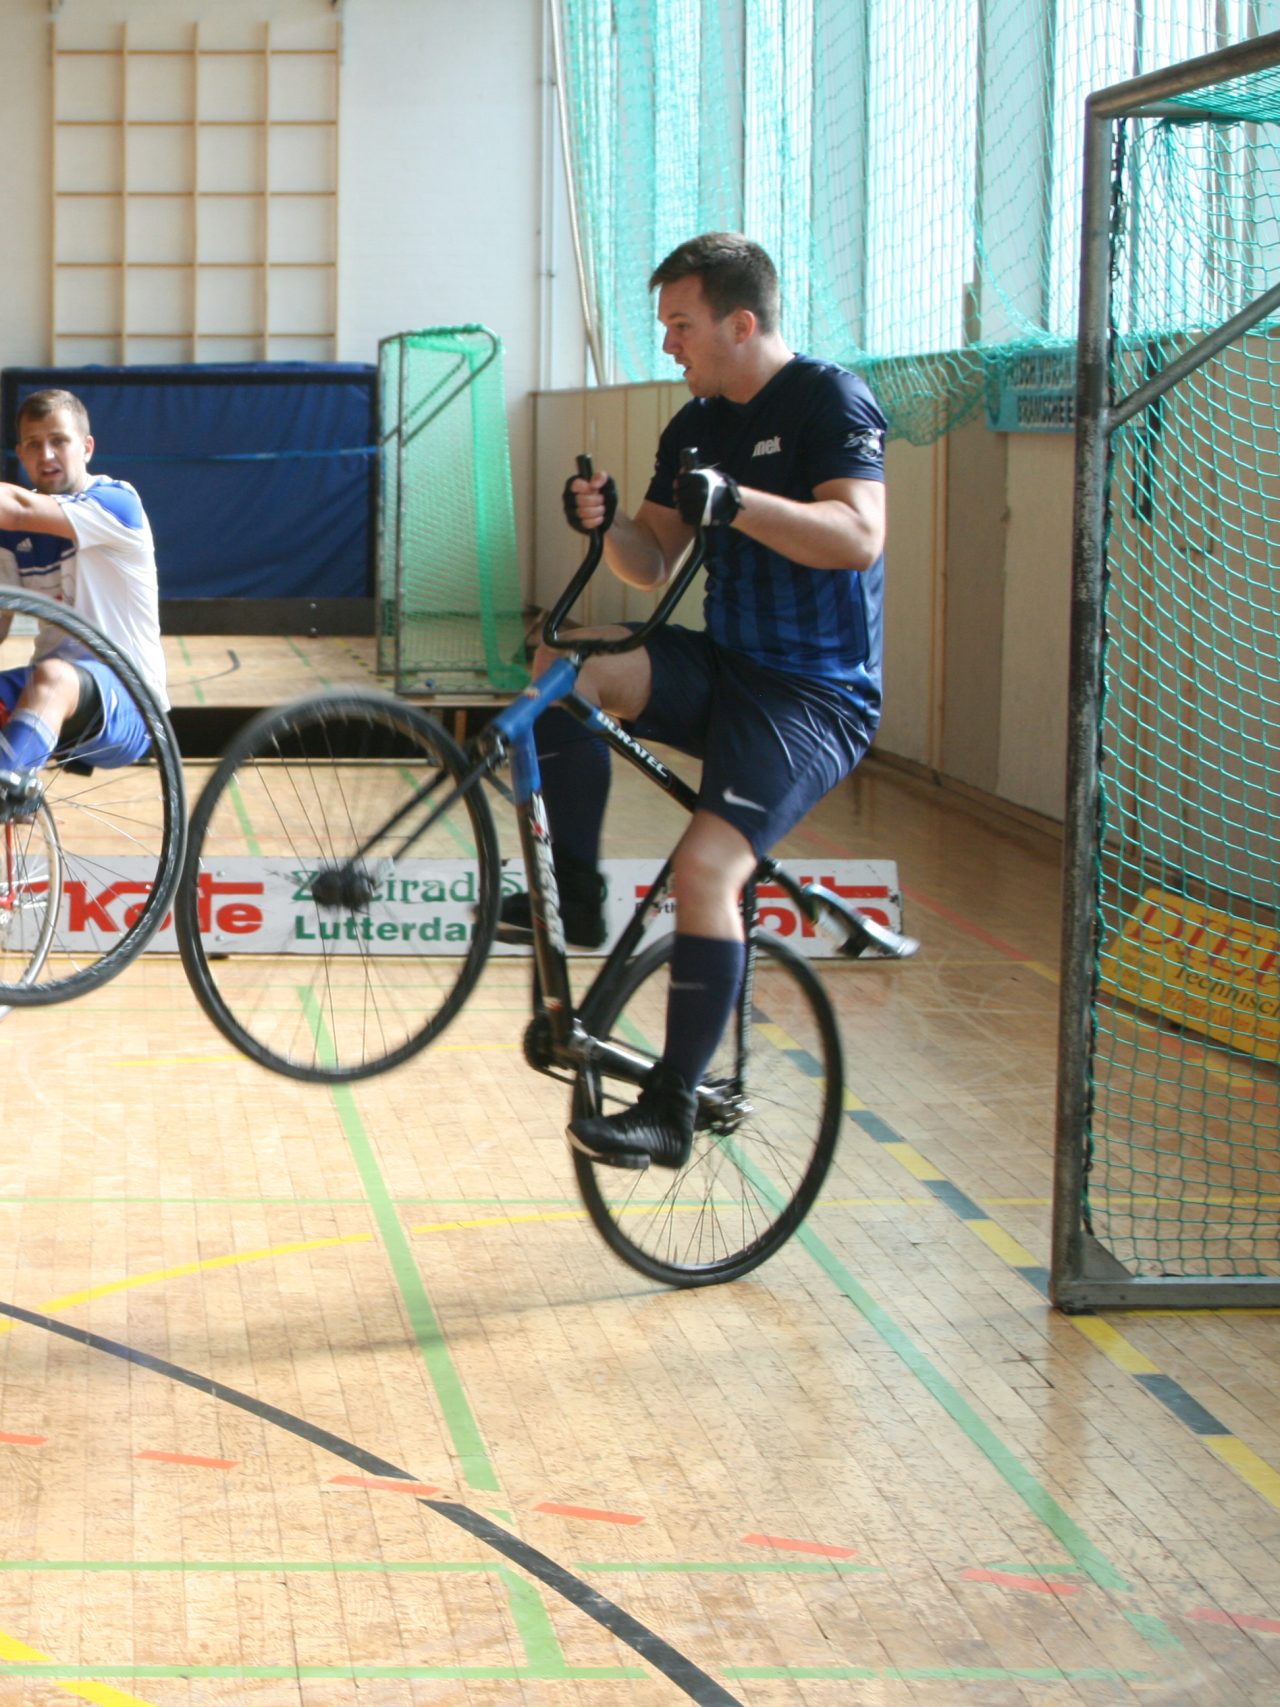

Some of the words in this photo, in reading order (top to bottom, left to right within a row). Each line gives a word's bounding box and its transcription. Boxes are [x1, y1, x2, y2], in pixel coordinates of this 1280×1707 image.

[64, 873, 264, 934] Kte
[291, 870, 477, 904] Zirad
[294, 915, 478, 942] Lutterda
